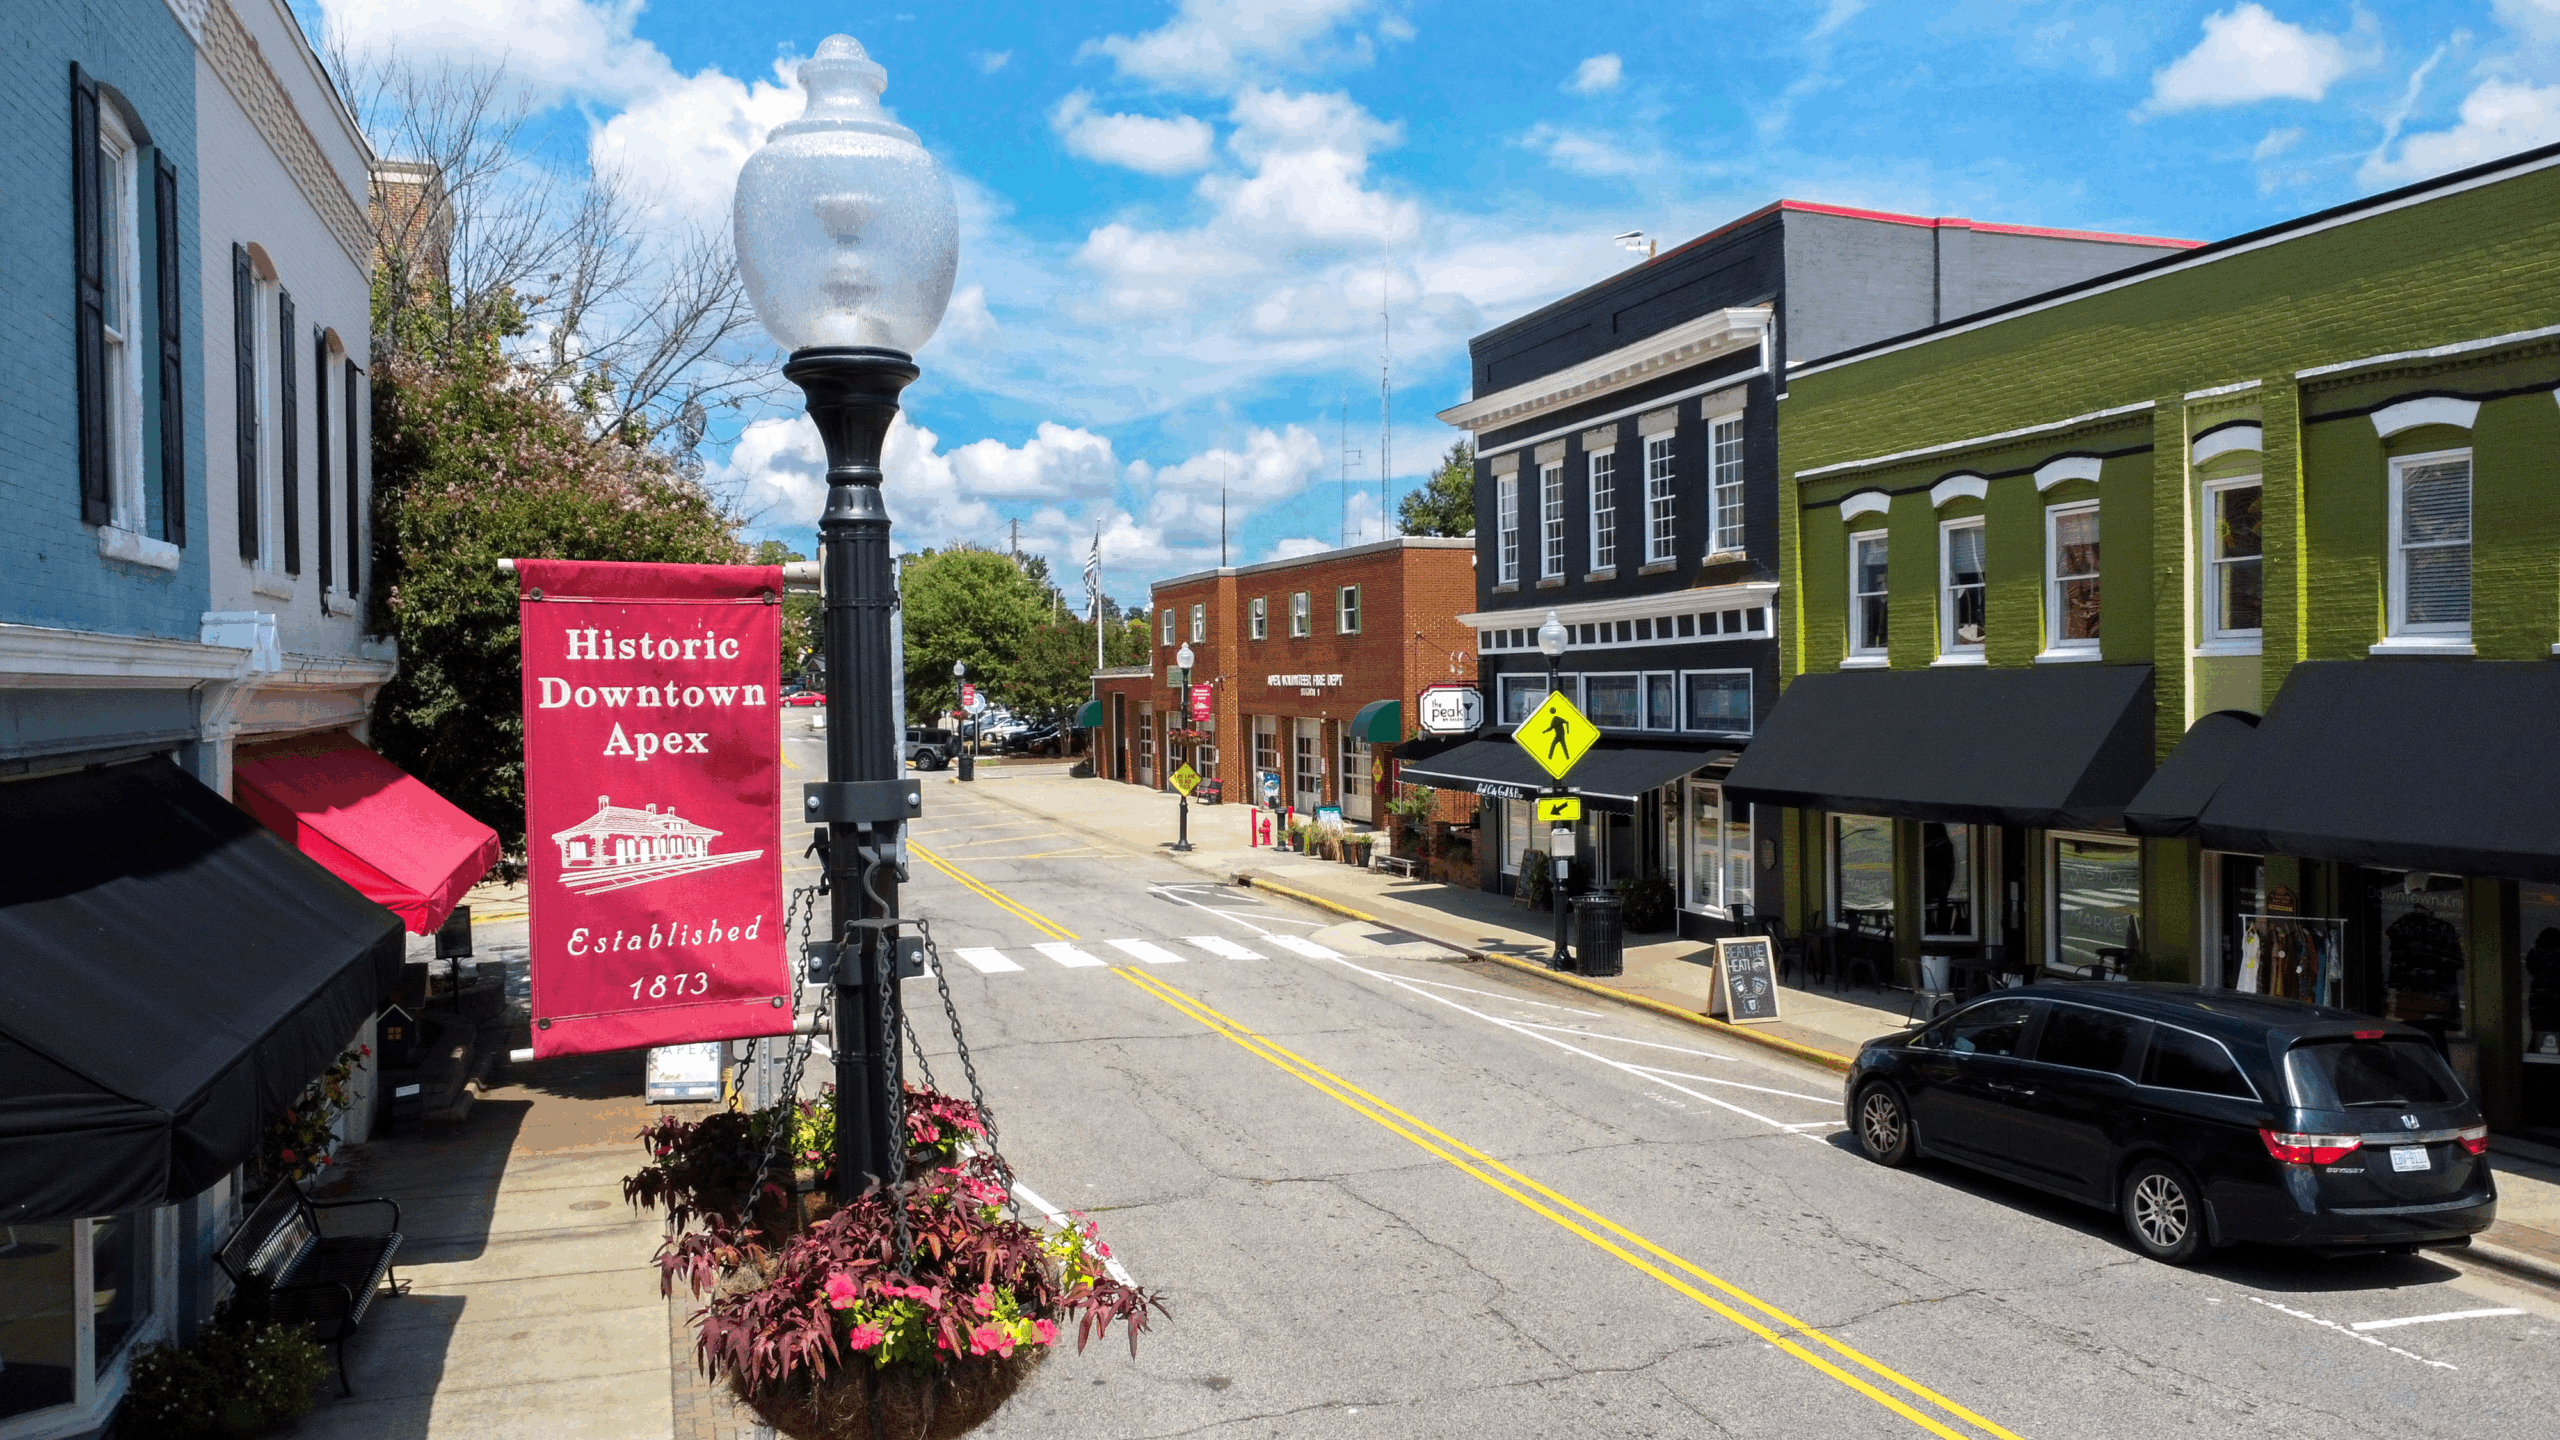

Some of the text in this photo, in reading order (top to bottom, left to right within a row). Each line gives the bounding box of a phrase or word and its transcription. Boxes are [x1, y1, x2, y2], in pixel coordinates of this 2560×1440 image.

[566, 627, 740, 661] Historic
[538, 676, 767, 709] Downtown
[1327, 673, 1344, 686] DEPT
[1432, 698, 1442, 708] the
[1432, 698, 1464, 722] peak
[603, 722, 710, 761] Apex
[566, 915, 761, 957] Established
[1725, 944, 1765, 959] BEAT THE
[628, 972, 710, 1001] 1873
